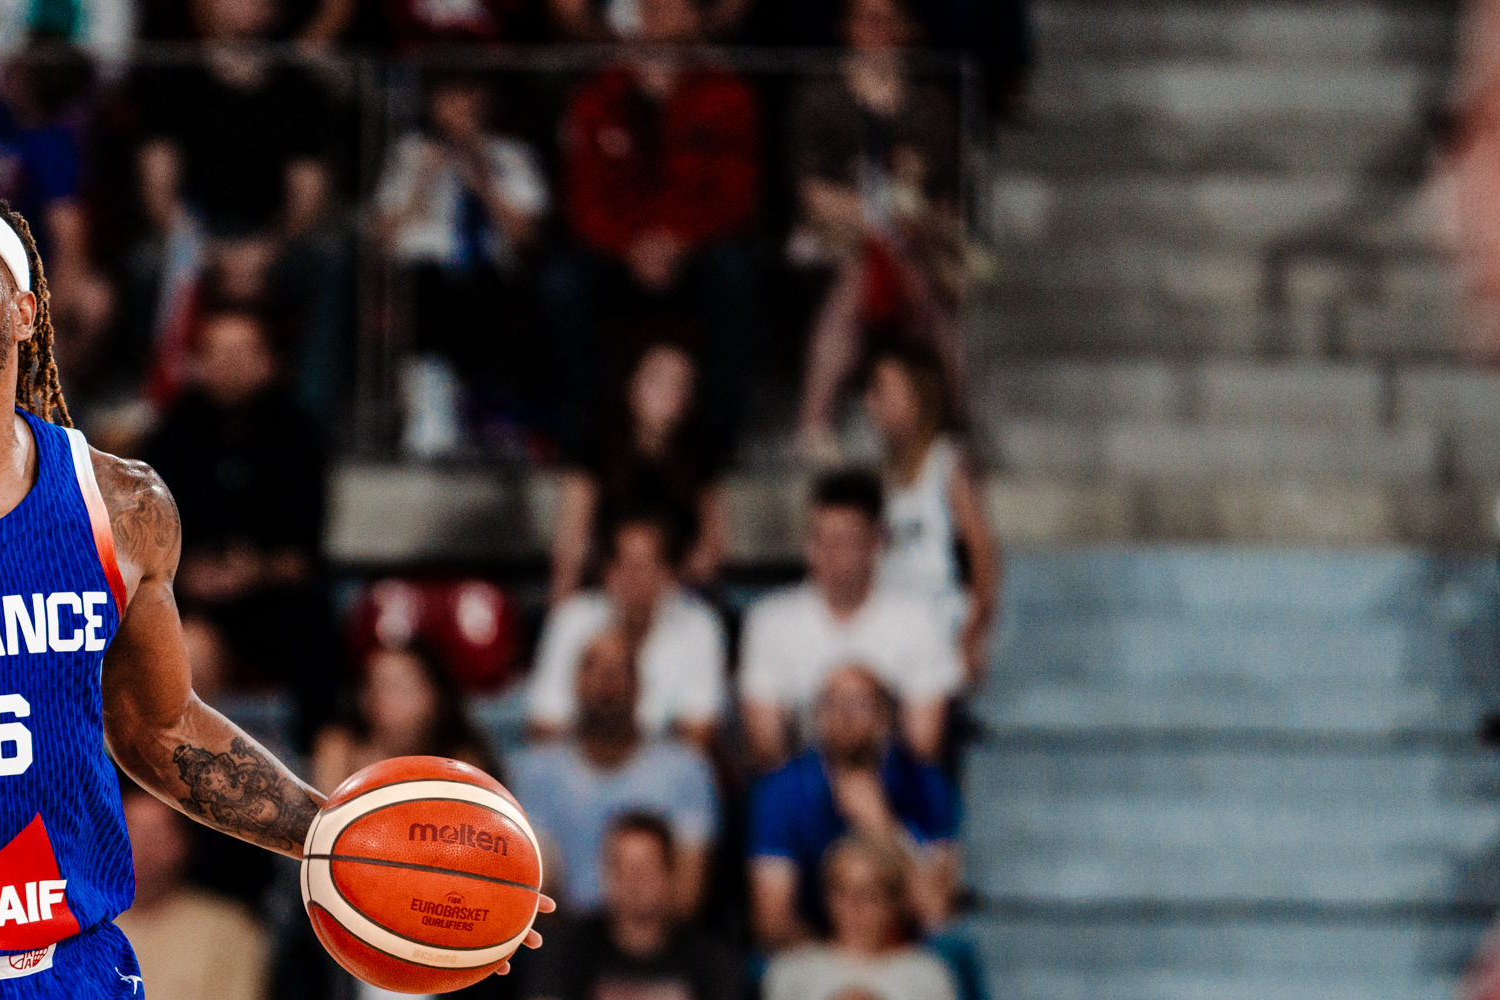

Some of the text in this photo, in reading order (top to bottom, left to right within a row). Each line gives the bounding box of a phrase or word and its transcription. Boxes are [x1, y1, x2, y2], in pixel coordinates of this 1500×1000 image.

[408, 822, 509, 857] molten
[410, 898, 490, 922] EUROBASKET
[421, 915, 474, 932] QUALIFIERS
